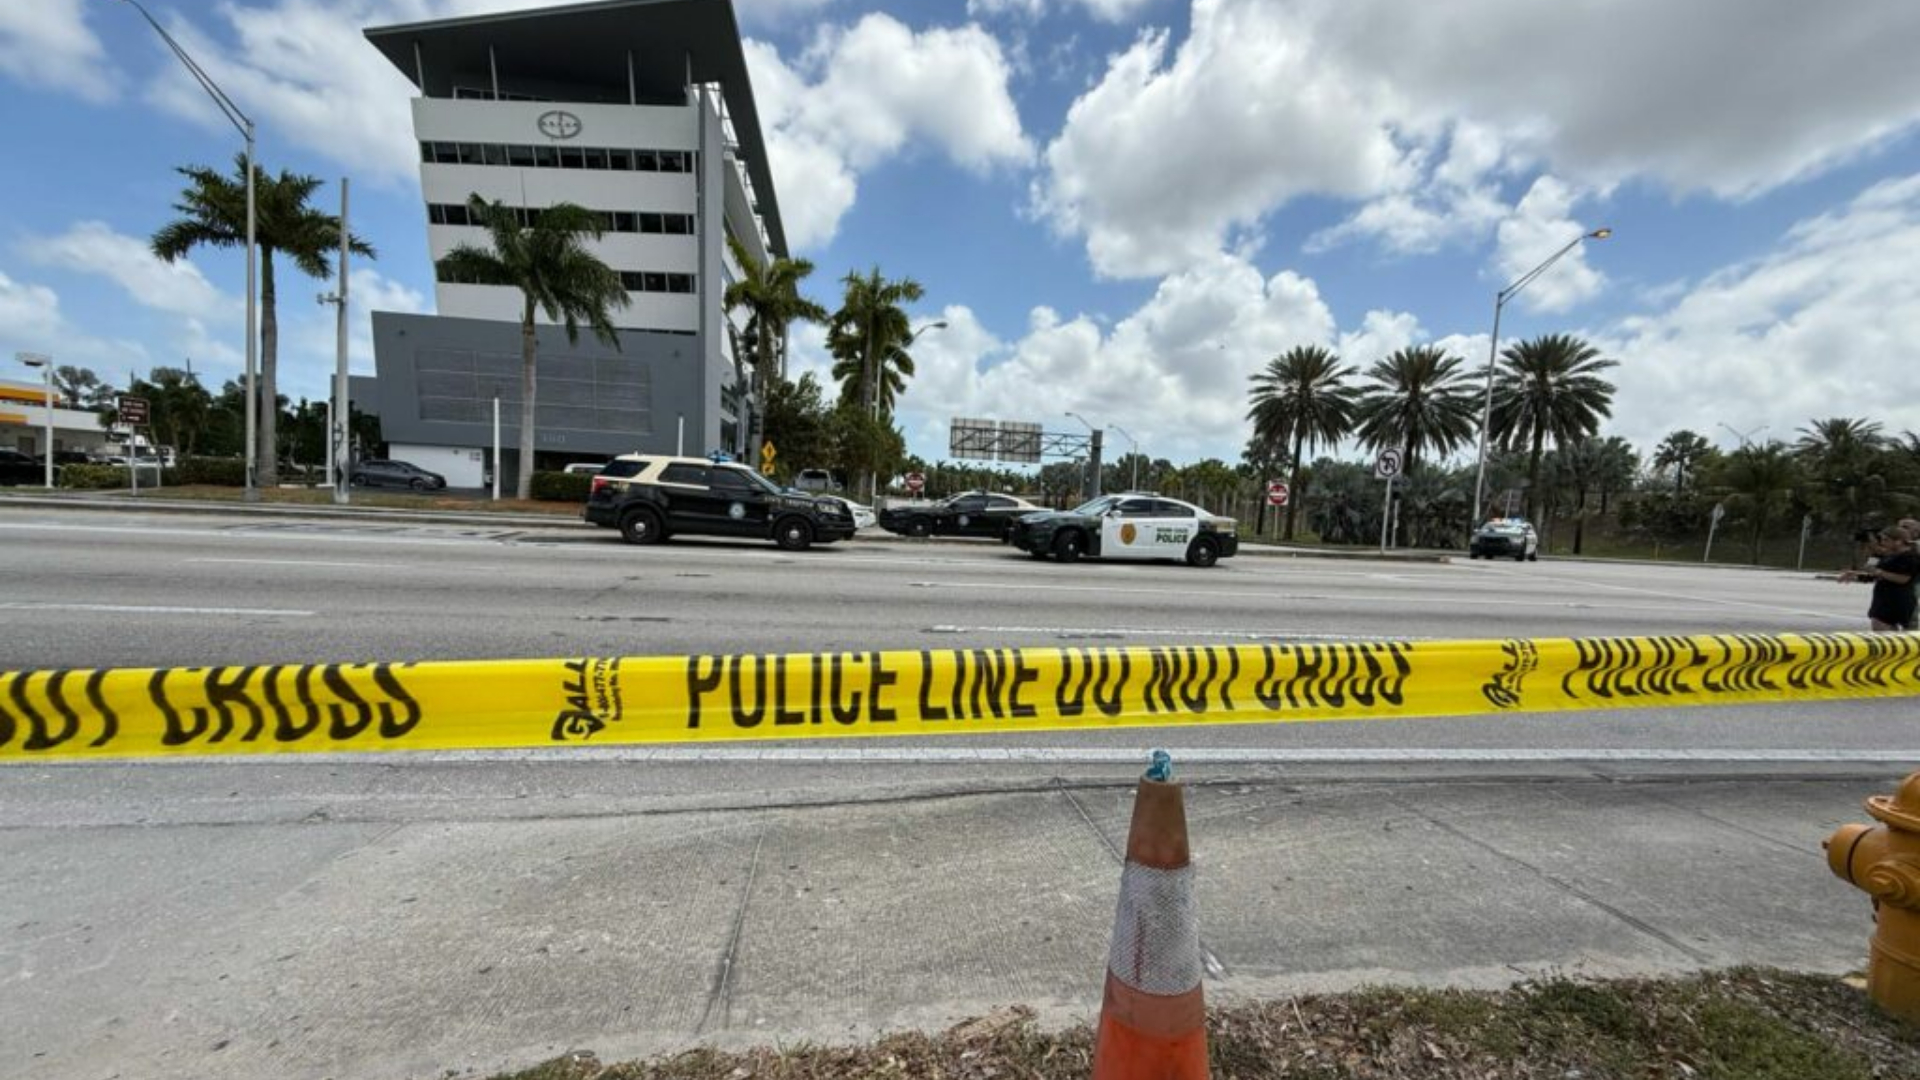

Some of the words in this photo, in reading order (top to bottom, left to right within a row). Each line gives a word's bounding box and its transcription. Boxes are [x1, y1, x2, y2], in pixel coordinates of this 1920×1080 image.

[1155, 533, 1188, 543] POLICE
[687, 653, 897, 729] POLICE
[919, 650, 1039, 720] LINE
[1055, 650, 1131, 717] DO
[1143, 646, 1240, 714] NOT
[1254, 642, 1413, 710] CROSS
[1561, 636, 1709, 699] POLICE
[148, 664, 421, 745] CROSS
